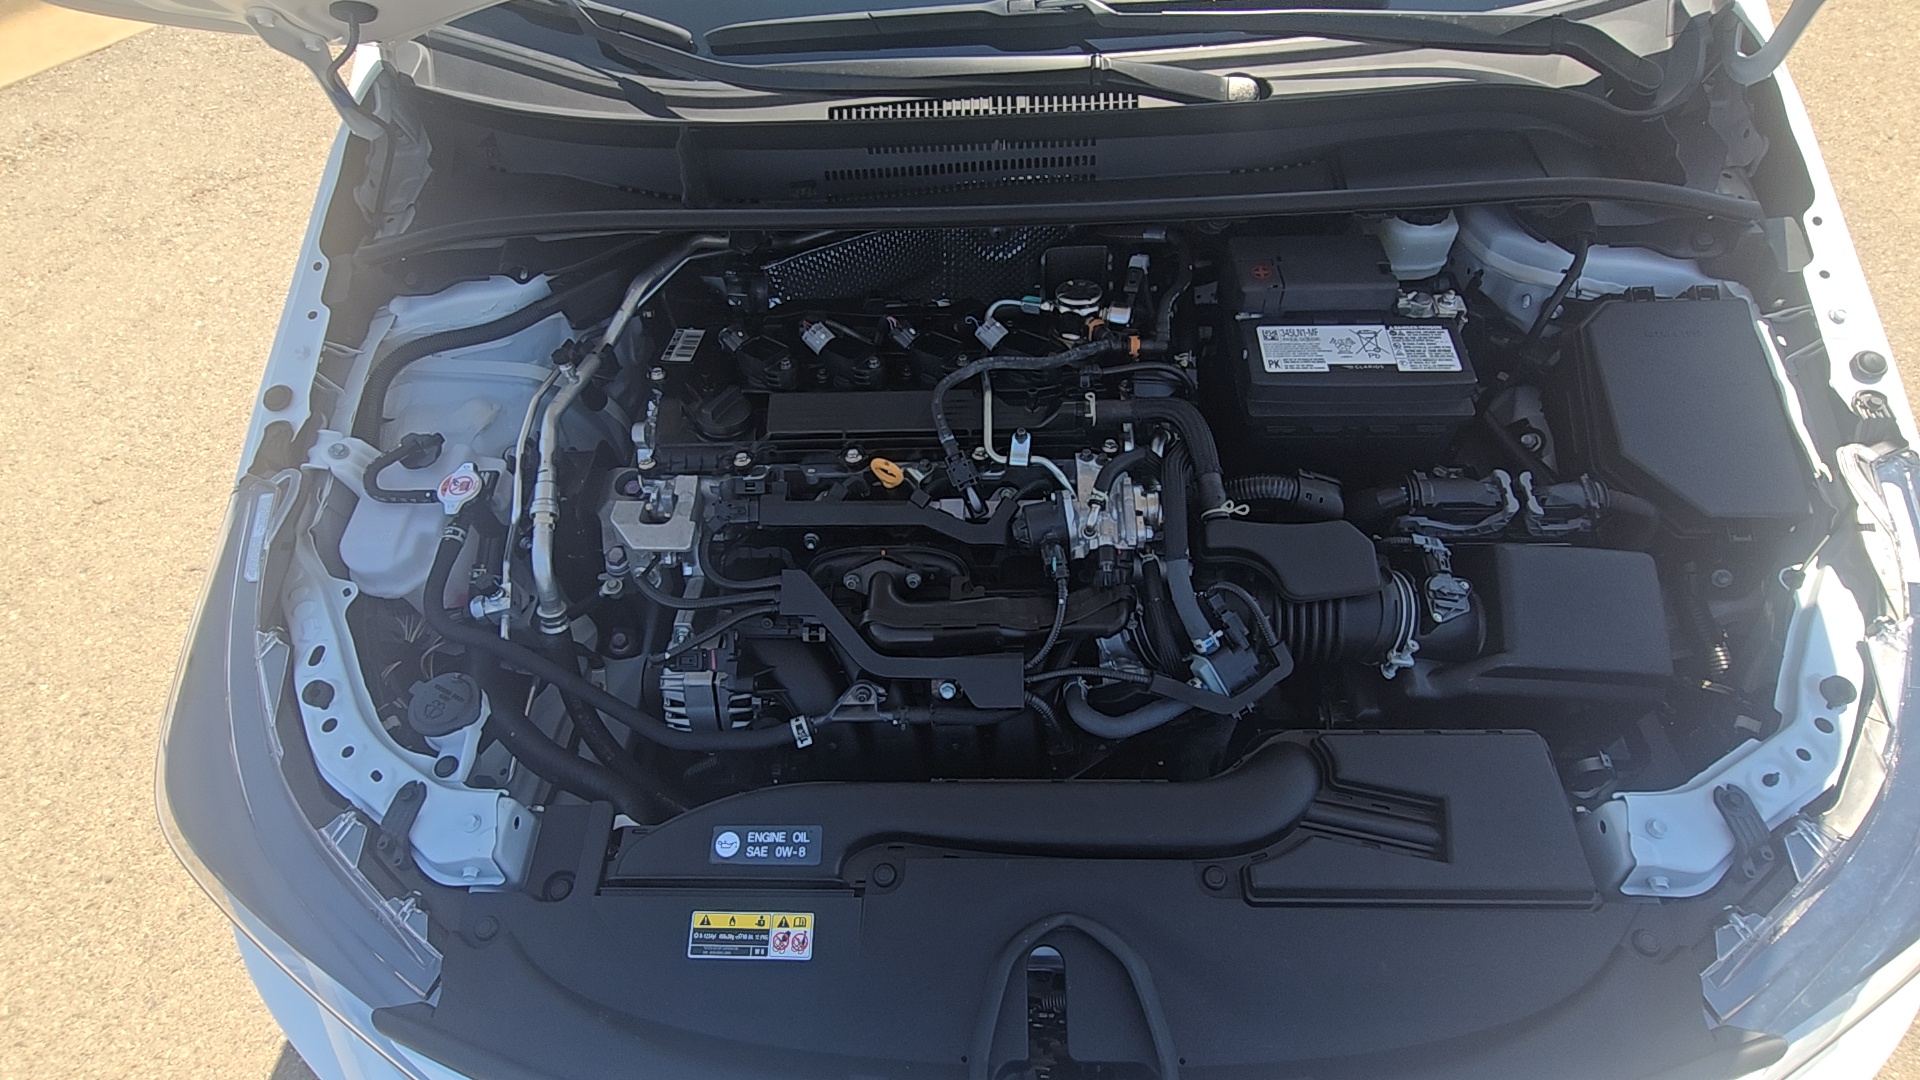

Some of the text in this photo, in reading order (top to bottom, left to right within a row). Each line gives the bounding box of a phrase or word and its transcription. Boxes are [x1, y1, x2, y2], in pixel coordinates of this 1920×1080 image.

[1268, 360, 1281, 369] PK
[747, 831, 810, 843] ENGINE OIL
[746, 846, 806, 857] SAE 0W-8
